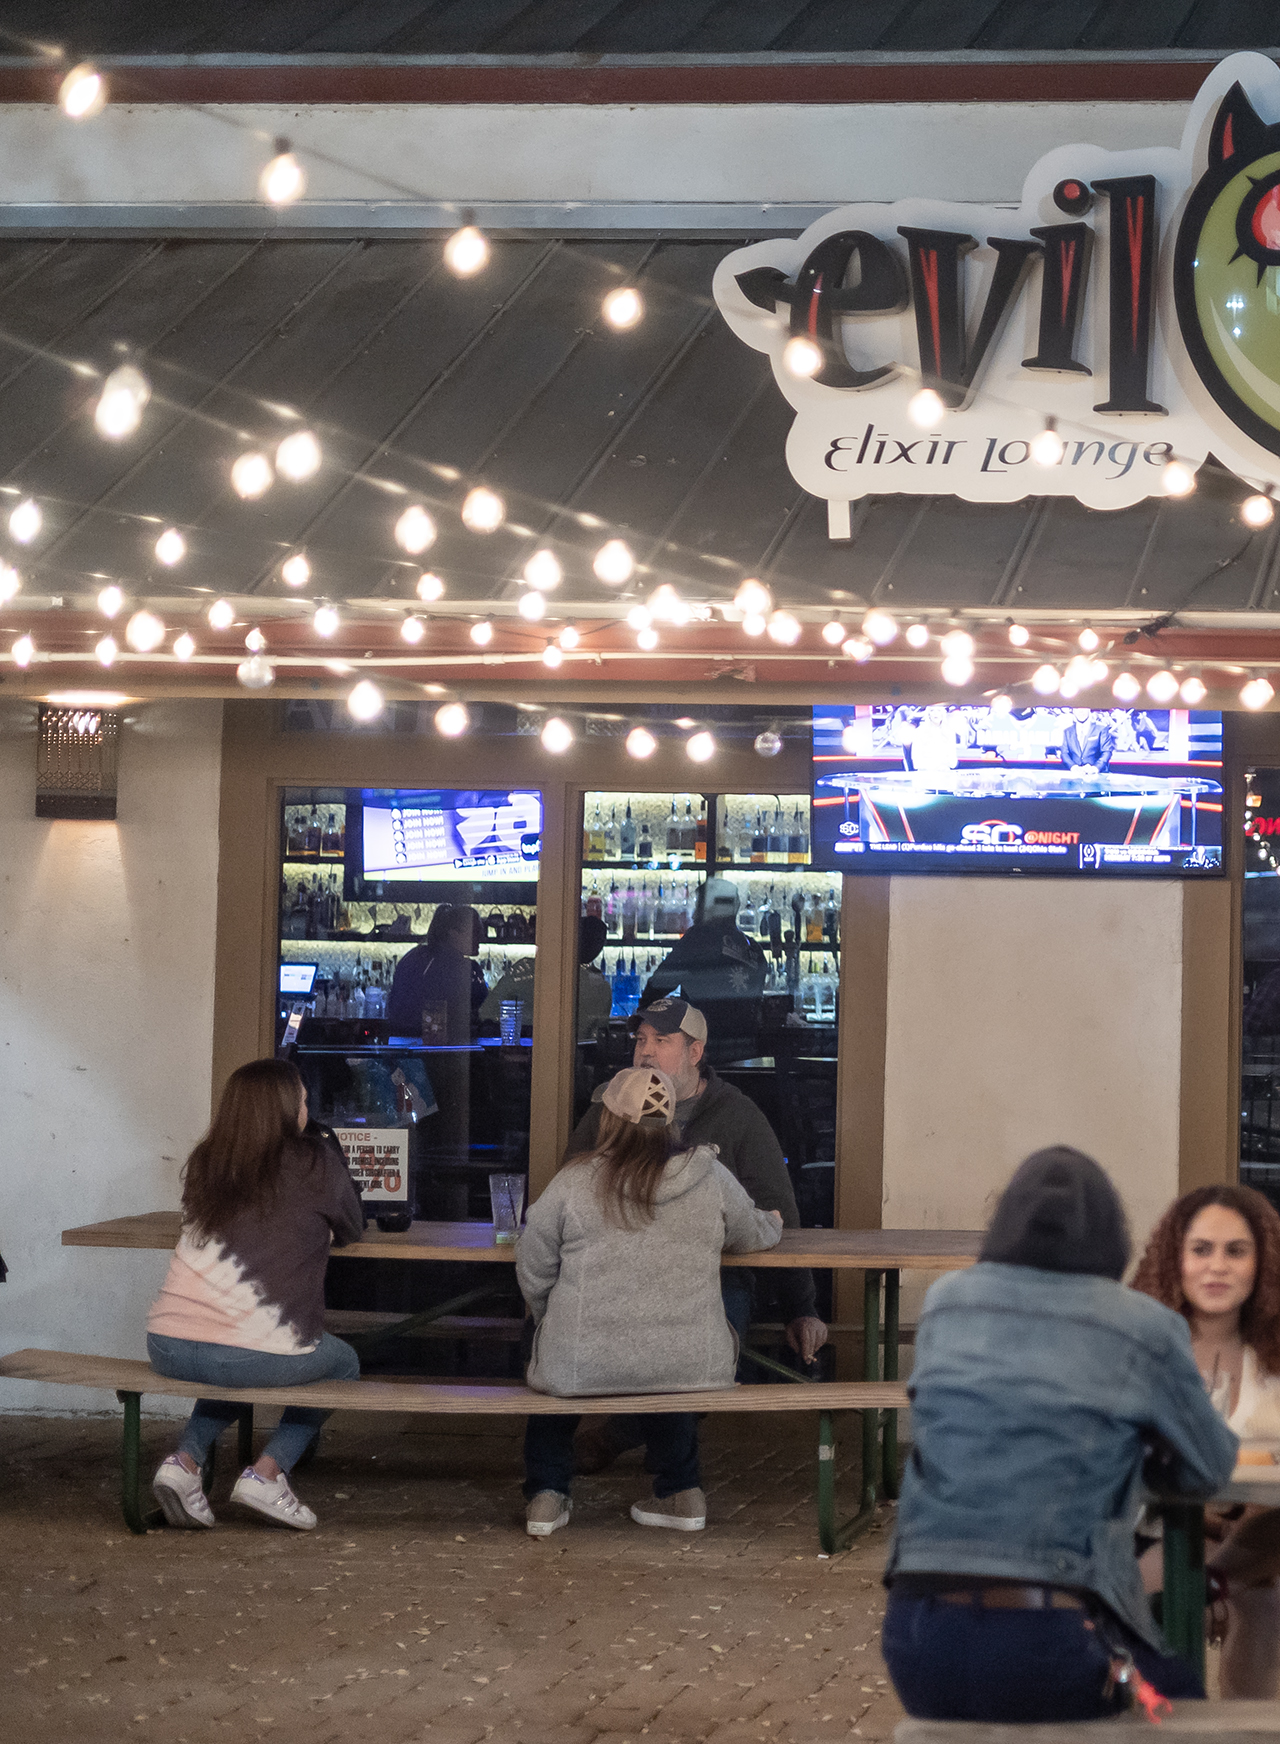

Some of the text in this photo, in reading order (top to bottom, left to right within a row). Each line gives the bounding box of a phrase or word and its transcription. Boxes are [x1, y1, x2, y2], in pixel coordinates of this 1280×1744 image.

[735, 174, 1170, 416] evil
[824, 423, 1174, 480] Elixir Longe
[509, 866, 522, 874] AND
[383, 1145, 400, 1155] CARRY
